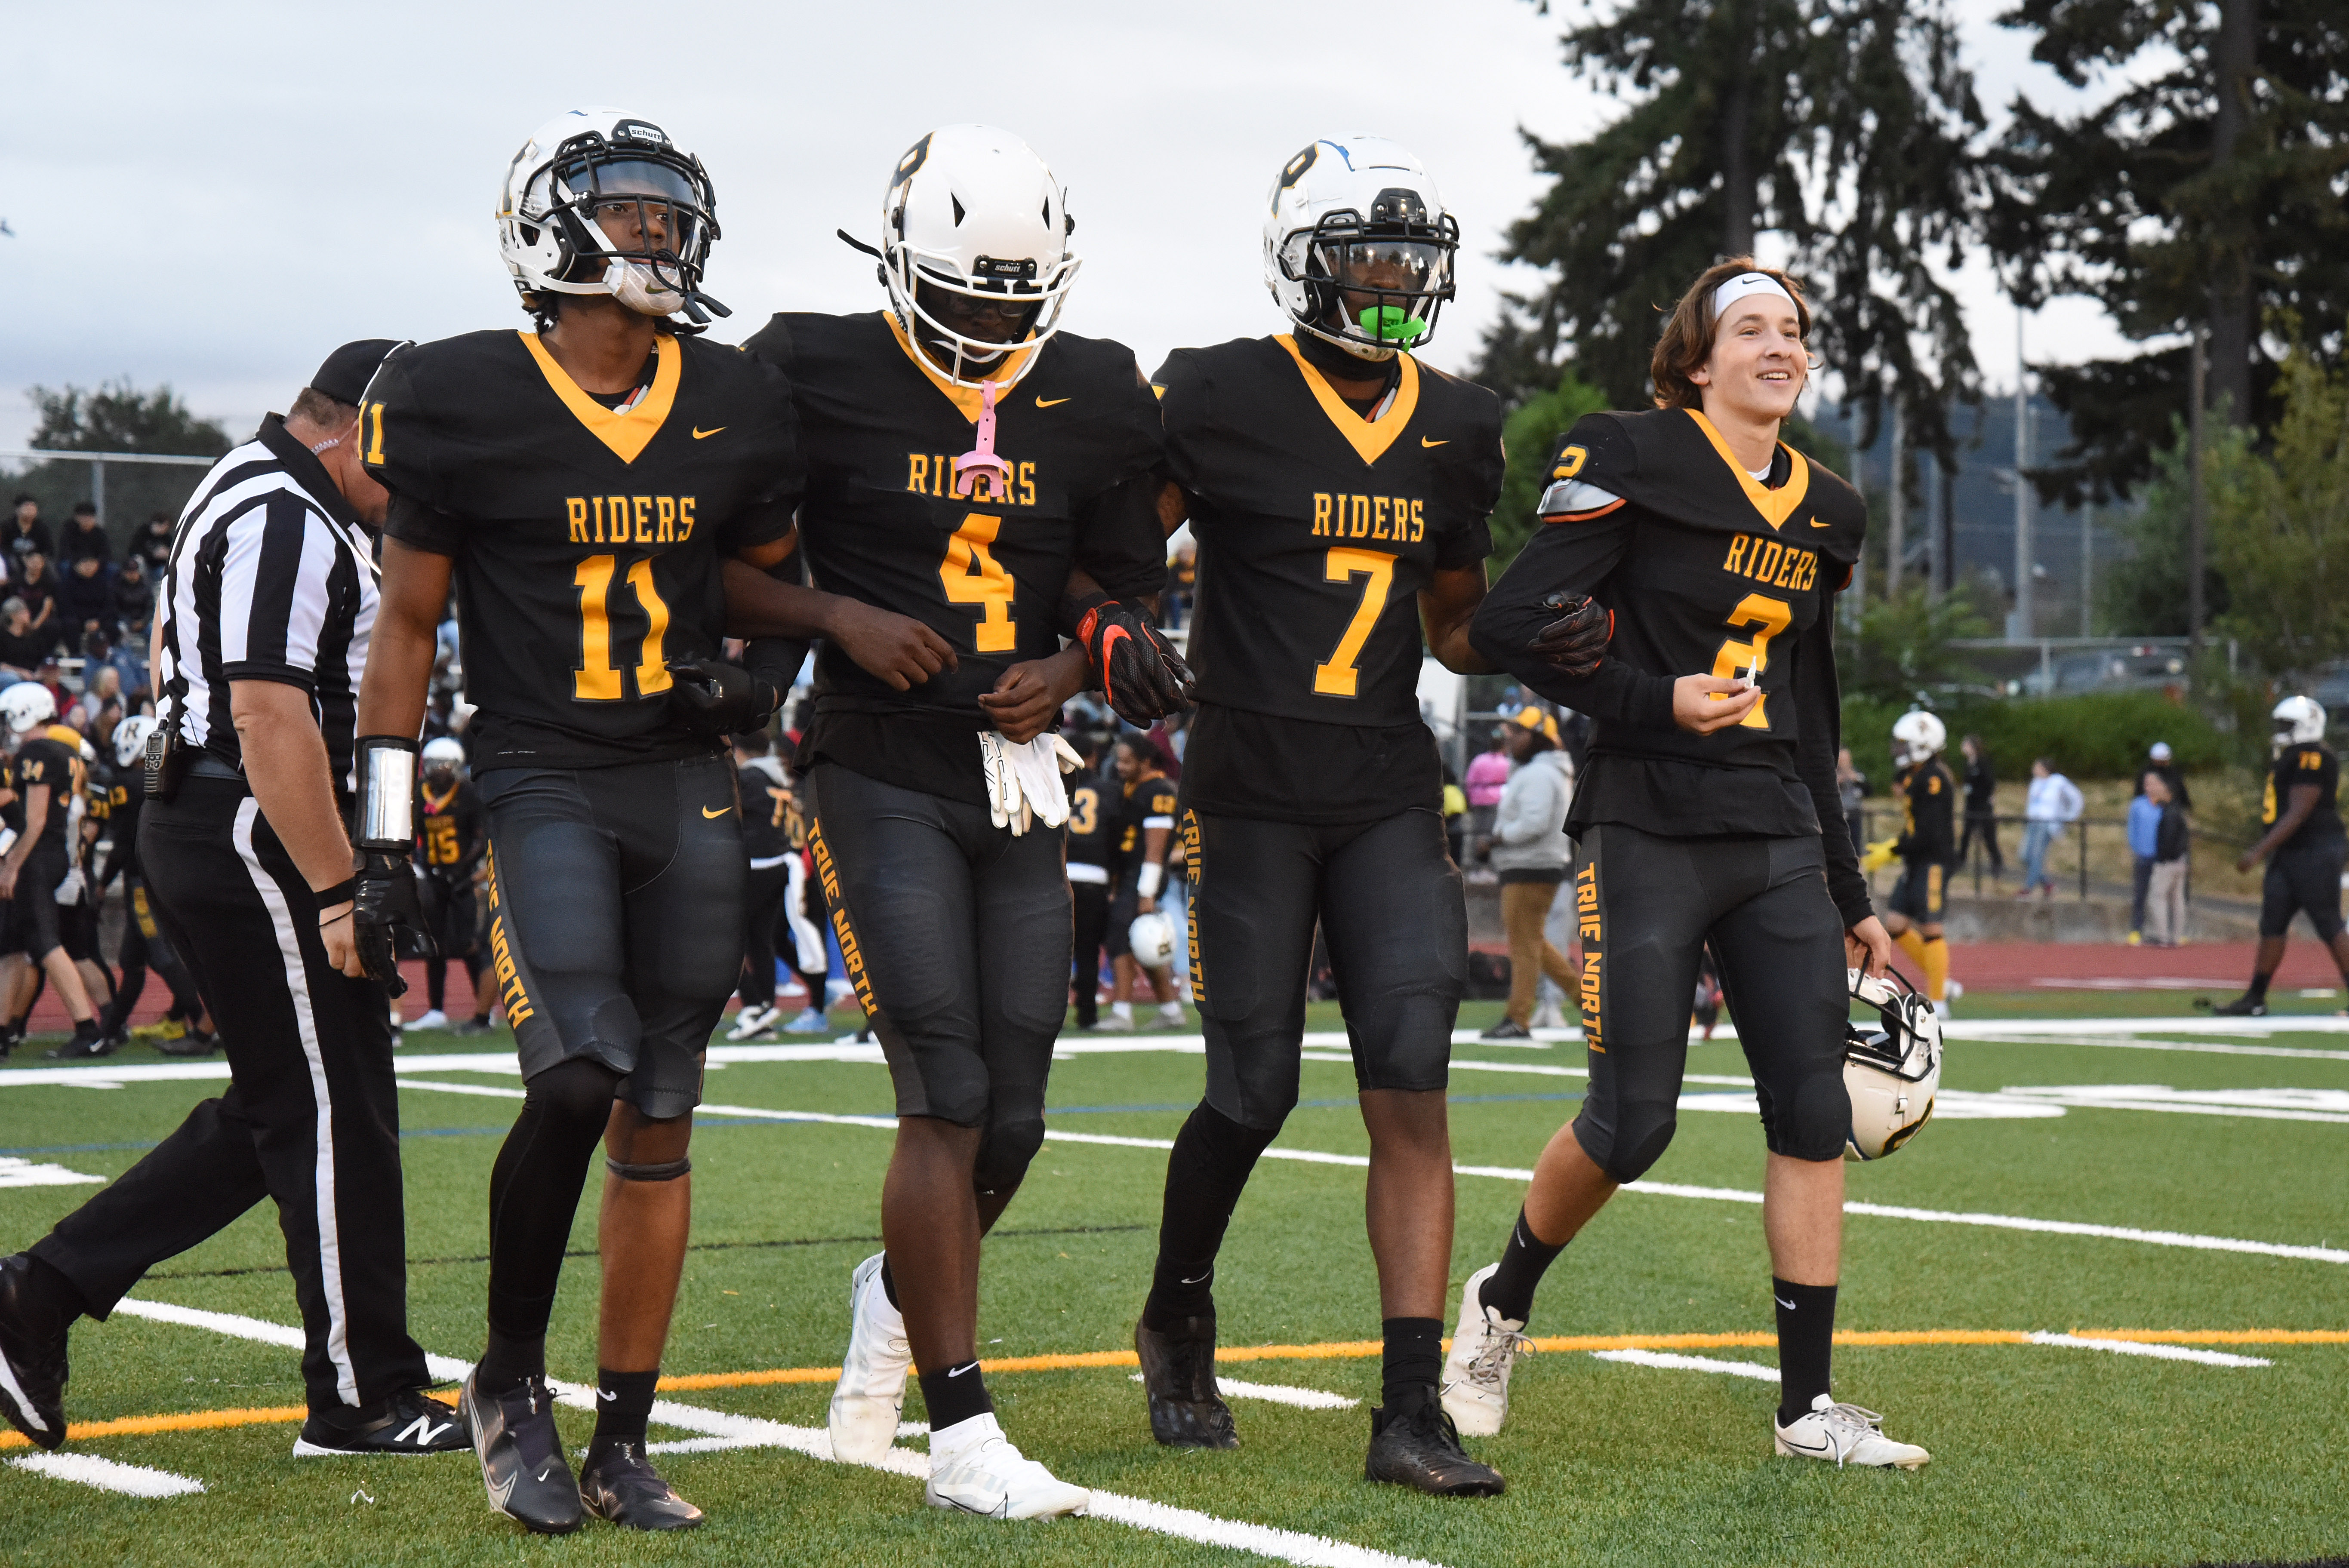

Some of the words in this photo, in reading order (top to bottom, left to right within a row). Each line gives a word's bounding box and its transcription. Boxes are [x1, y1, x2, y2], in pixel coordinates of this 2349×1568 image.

[631, 129, 661, 140] schutt
[994, 264, 1021, 272] schutt
[1553, 446, 1587, 480] 2
[566, 496, 696, 543] RIDERS
[1311, 493, 1425, 543] RIDERS
[939, 513, 1016, 653] 4
[1724, 532, 1817, 591] RIDERS
[574, 554, 673, 700] 11
[1314, 547, 1399, 696] 7
[1709, 593, 1792, 729] 2
[428, 827, 460, 864] 15
[1183, 808, 1201, 885] TRUE
[808, 817, 840, 907] TRUE
[834, 908, 878, 1017] NORTH
[1577, 862, 1601, 942] TRUE
[1188, 896, 1206, 1002] NORTH
[1581, 952, 1606, 1055] NORTH
